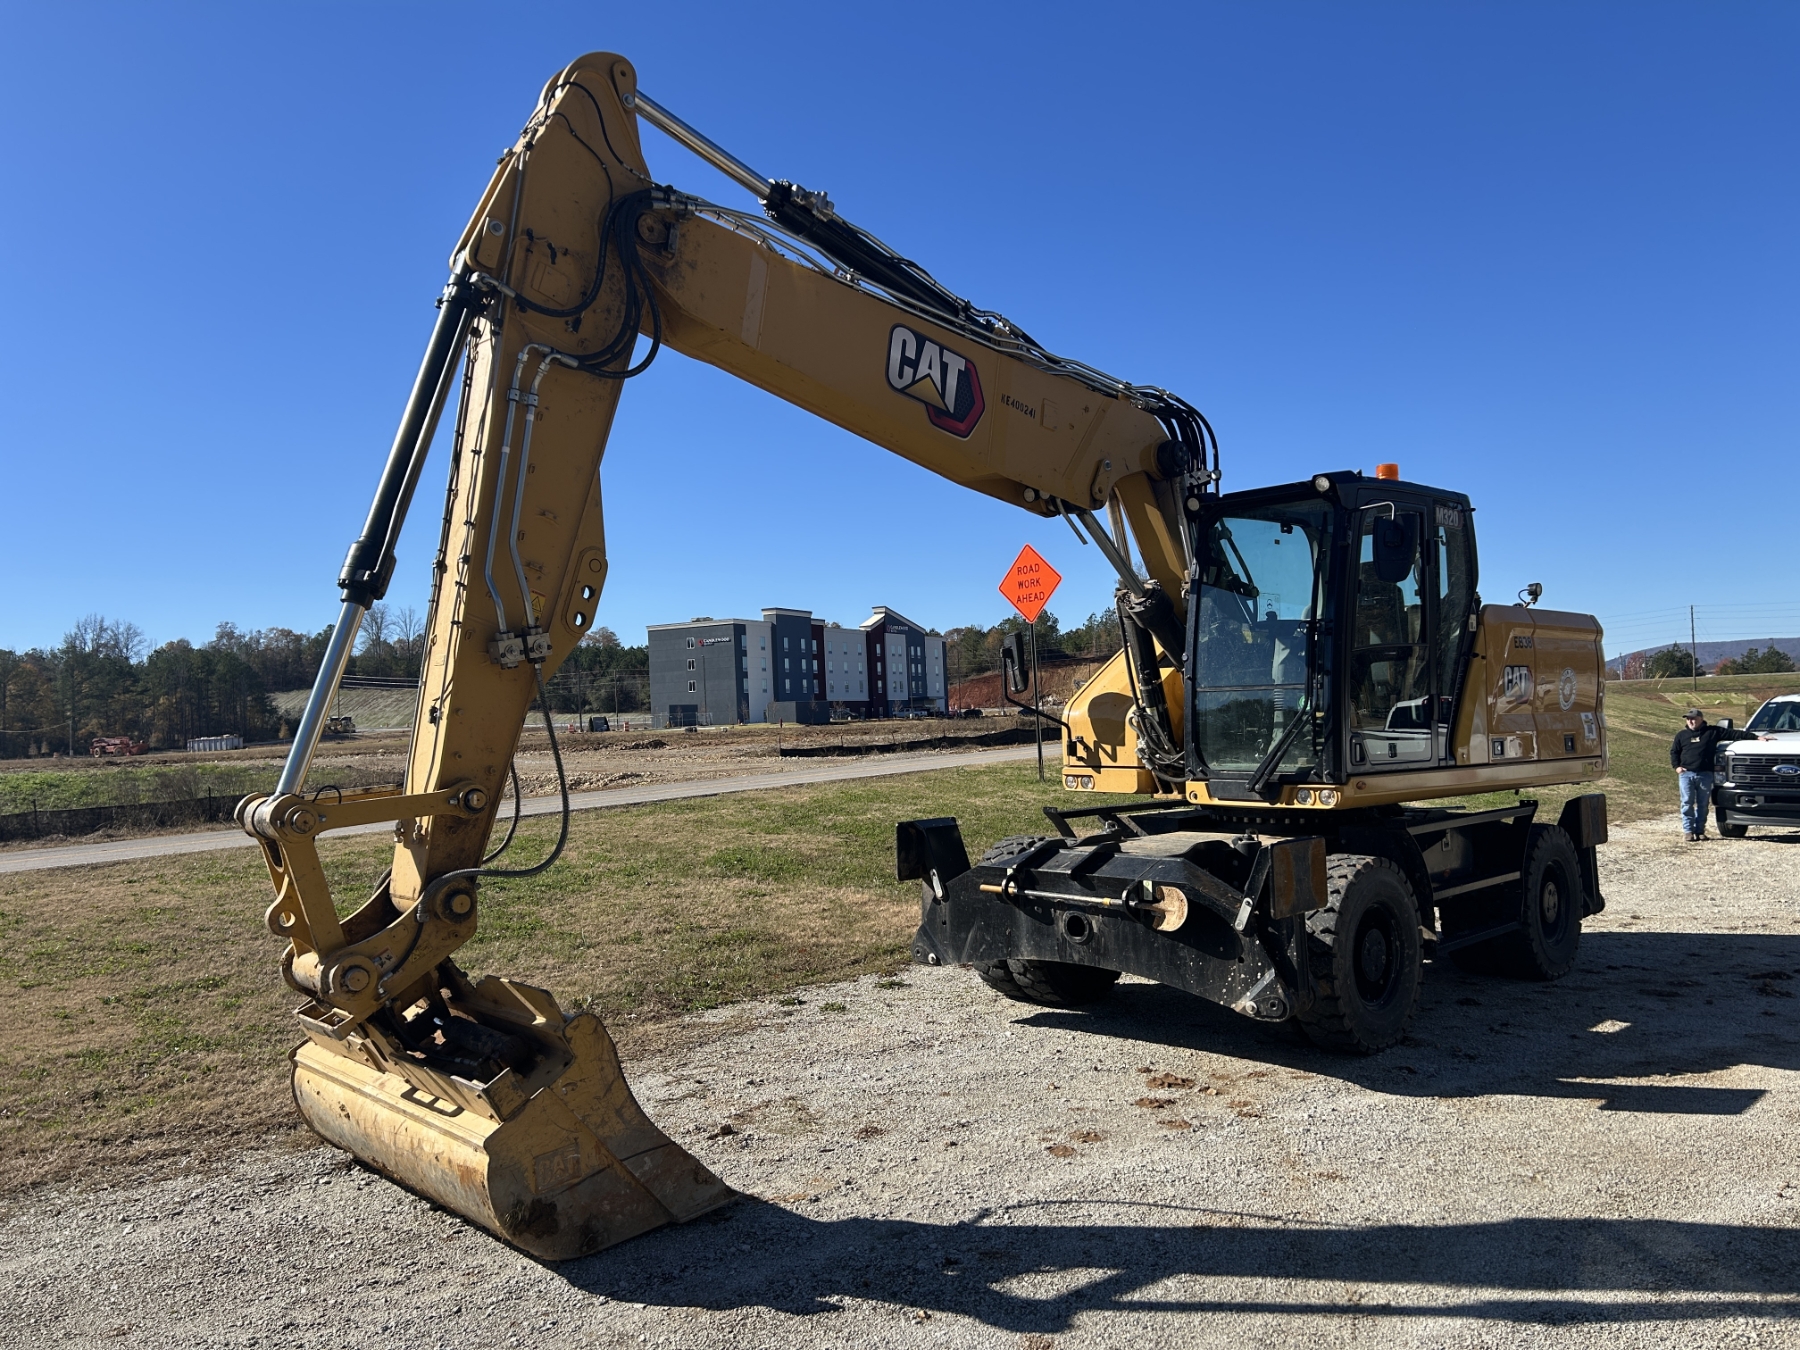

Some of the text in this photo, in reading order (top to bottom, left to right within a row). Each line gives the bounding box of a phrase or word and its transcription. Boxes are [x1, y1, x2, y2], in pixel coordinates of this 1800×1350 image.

[888, 326, 966, 414] CAT
[1435, 506, 1459, 527] M320
[1017, 564, 1040, 576] ROAD
[1018, 578, 1041, 589] WORK
[1016, 591, 1045, 604] AHEAD
[1504, 666, 1528, 697] CAT
